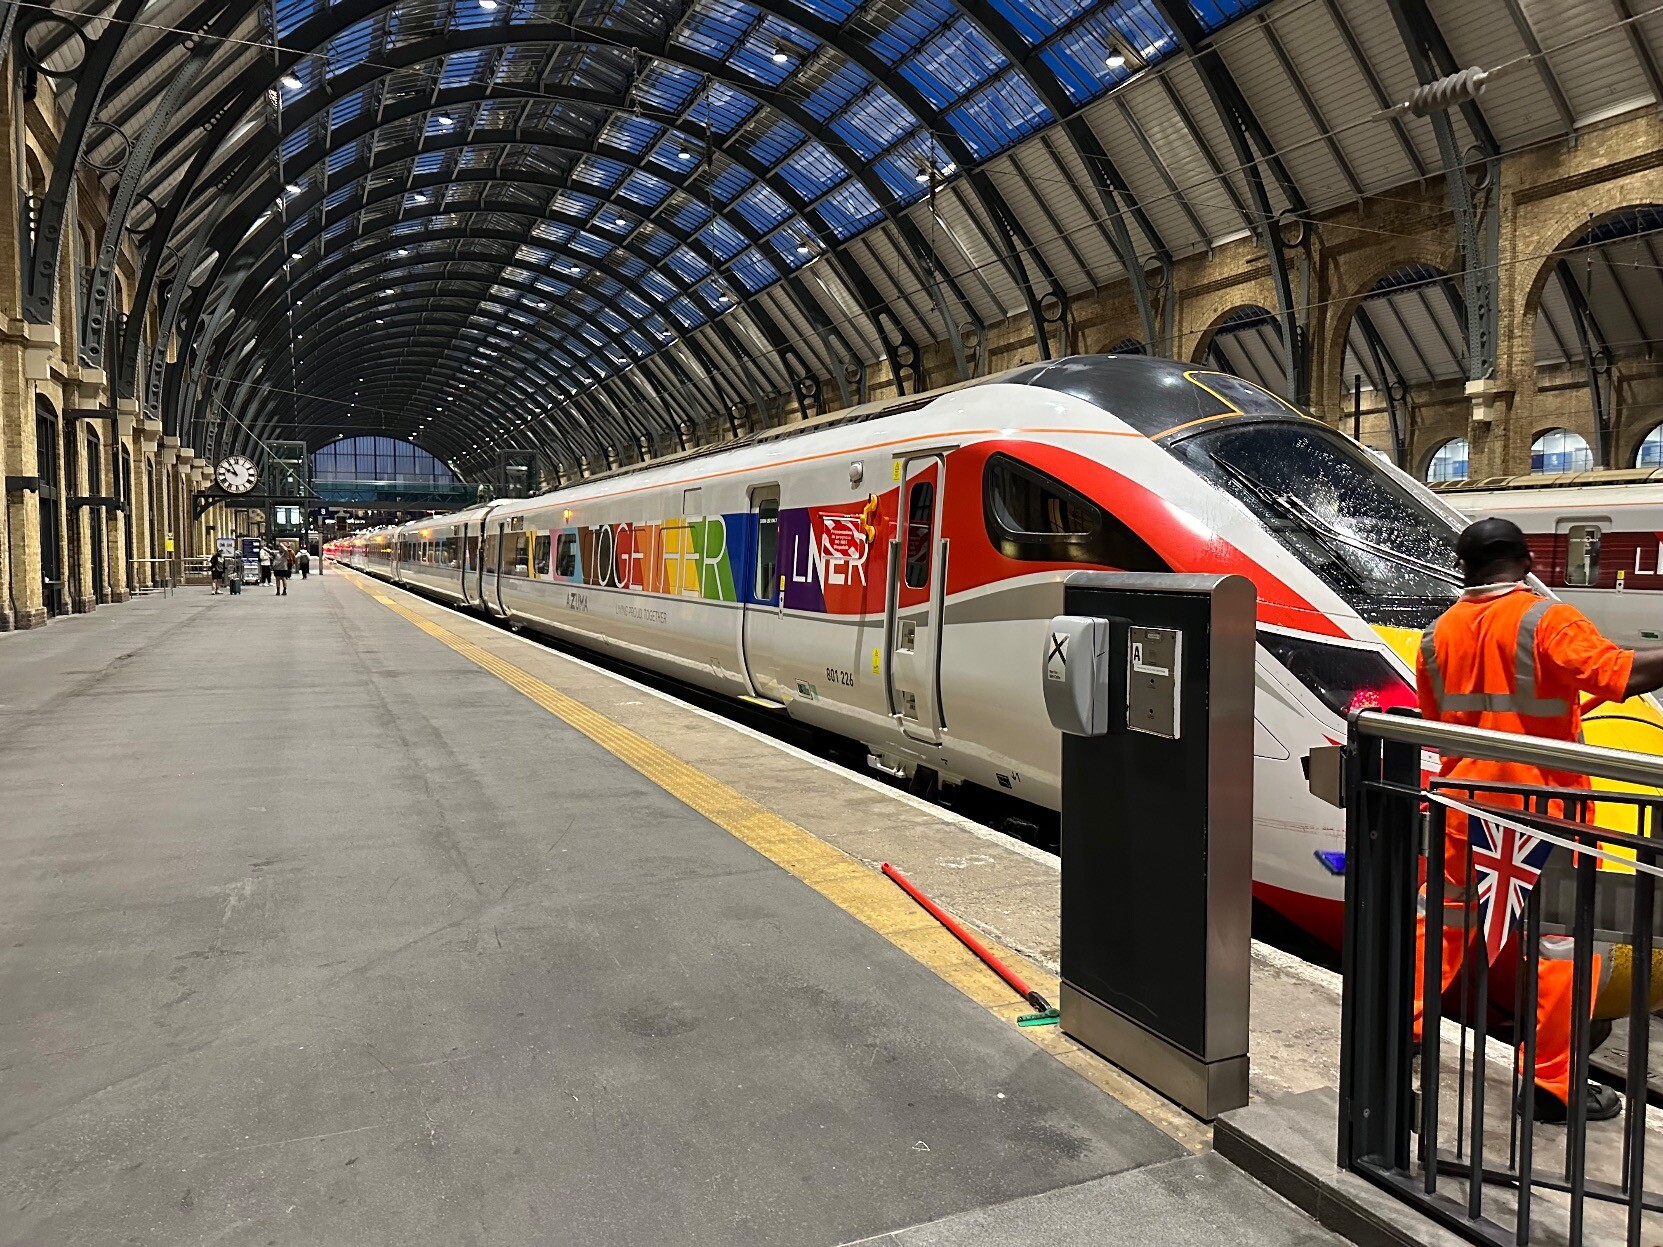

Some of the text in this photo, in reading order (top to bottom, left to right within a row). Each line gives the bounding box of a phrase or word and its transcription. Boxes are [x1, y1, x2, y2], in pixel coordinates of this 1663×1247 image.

[587, 514, 727, 601] TOGETHER
[793, 524, 868, 595] LNER
[566, 592, 588, 612] AZUMA
[1133, 646, 1141, 662] A
[826, 668, 854, 687] 801 226
